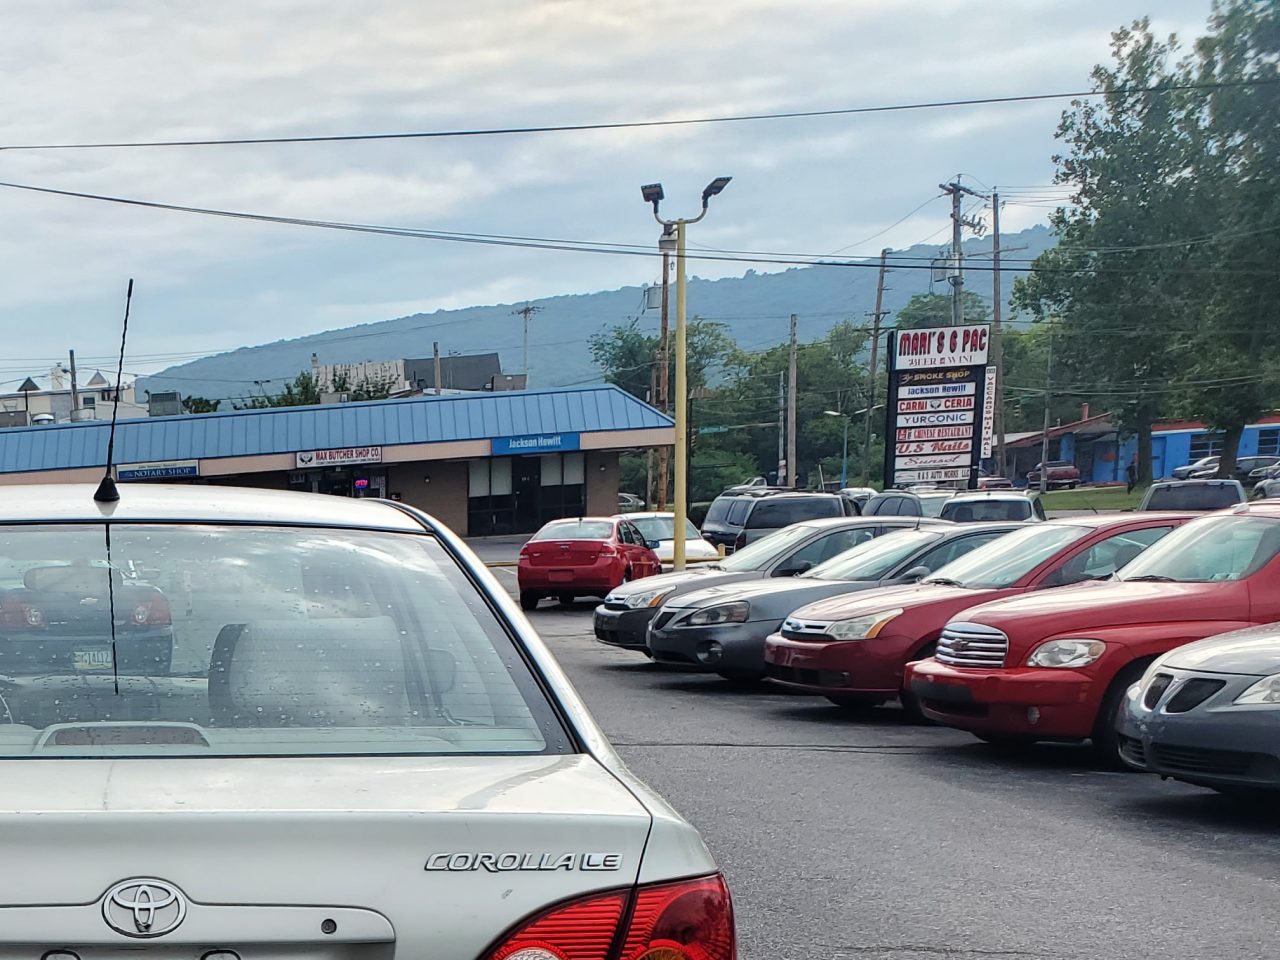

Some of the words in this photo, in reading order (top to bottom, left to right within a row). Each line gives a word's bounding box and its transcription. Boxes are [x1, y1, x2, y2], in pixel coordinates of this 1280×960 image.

[899, 331, 945, 356] MARI'S
[962, 328, 987, 352] PAC
[914, 371, 945, 380] SMOKE
[946, 370, 970, 379] SHOP
[908, 387, 940, 395] Jackson
[941, 384, 967, 393] Hewitt
[899, 401, 927, 411] CARNI
[944, 398, 972, 408] CERIA
[904, 414, 967, 424] YURCONIC
[914, 428, 936, 439] CHINESE
[937, 426, 972, 438] RESTAURANT
[508, 438, 537, 449] Jackson
[538, 436, 561, 447] Hewitt
[930, 441, 970, 452] Nails
[983, 437, 991, 456] MALL
[315, 451, 328, 461] MAX
[328, 449, 354, 460] BUTCHER
[355, 448, 370, 458] SHOP
[134, 469, 166, 478] NOTARY
[168, 467, 191, 475] SHOP
[930, 471, 943, 479] AUTO
[424, 853, 576, 873] COROLLA
[579, 853, 624, 872] LE
